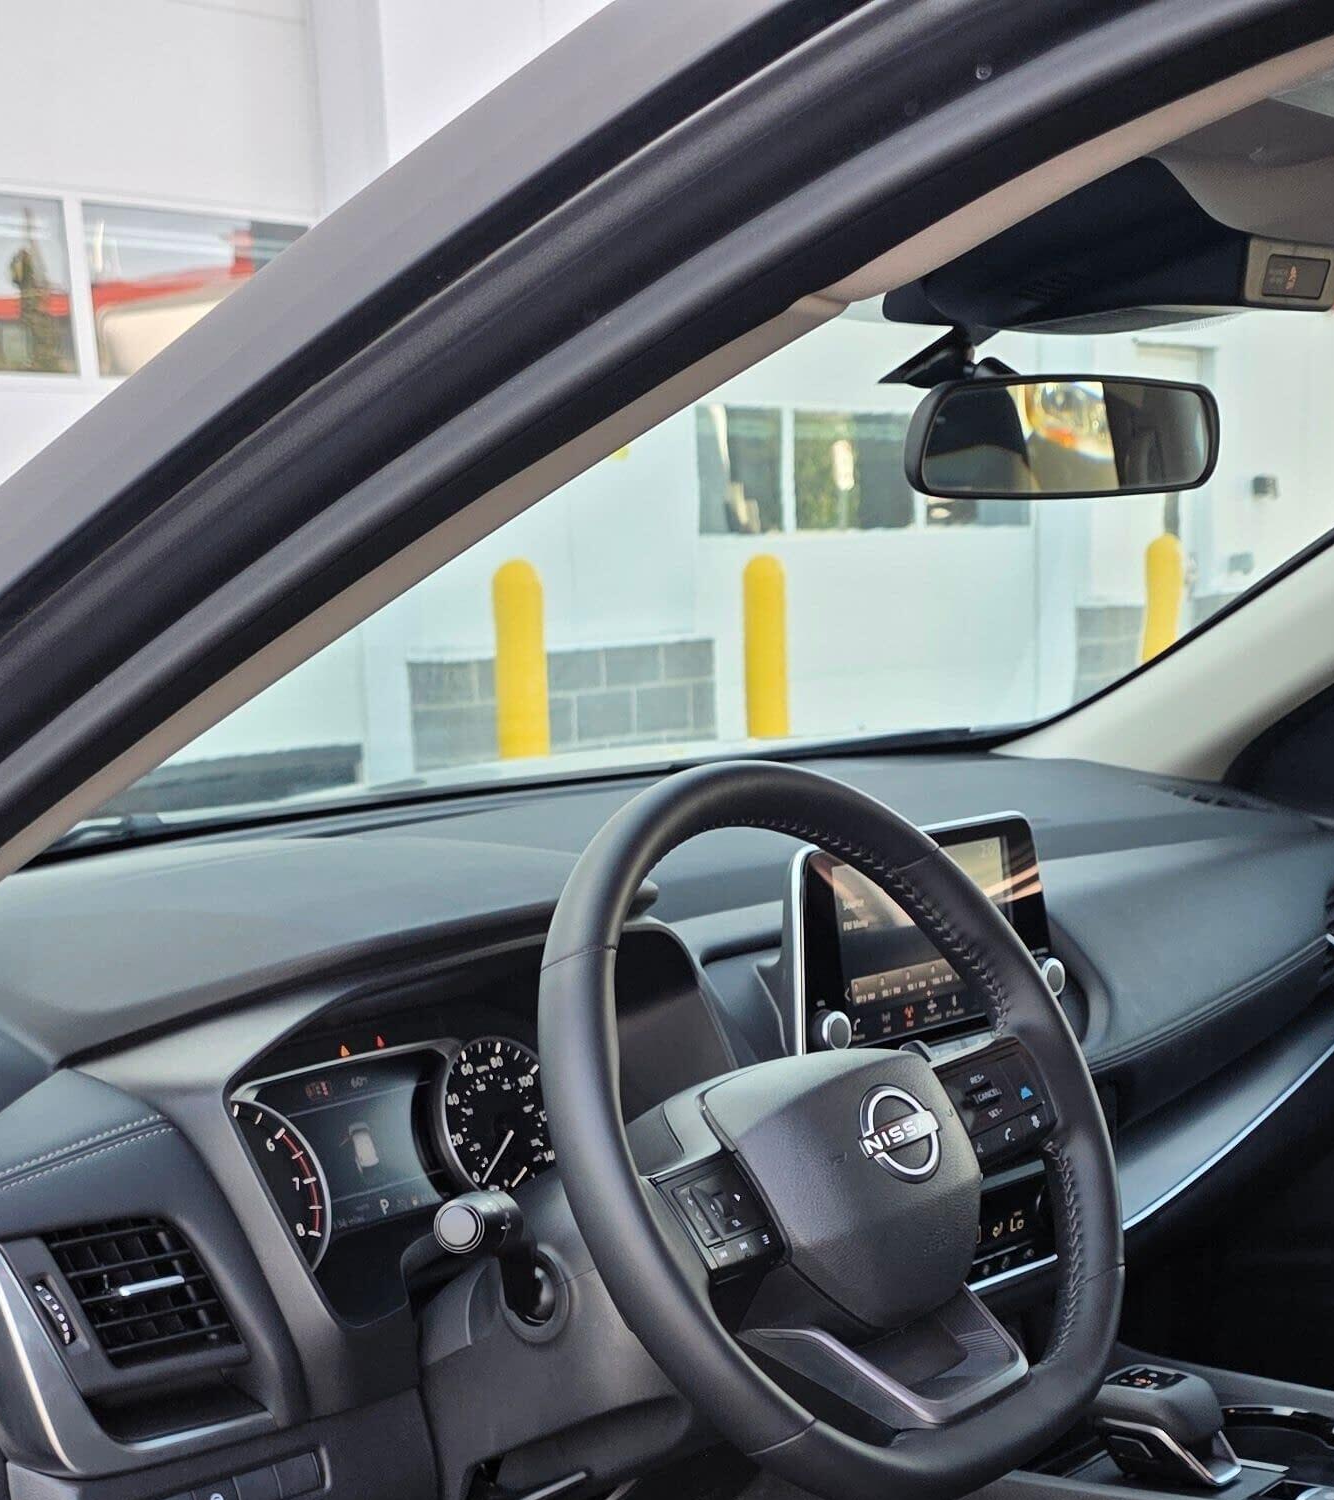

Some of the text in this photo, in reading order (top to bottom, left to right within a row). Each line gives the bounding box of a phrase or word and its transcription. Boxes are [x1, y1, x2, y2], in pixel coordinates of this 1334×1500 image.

[490, 1055, 503, 1068] 80
[461, 1063, 473, 1076] 60
[518, 1074, 534, 1087] 100
[447, 1093, 459, 1105] 40
[451, 1133, 463, 1146] 20
[863, 1113, 931, 1155] NISS
[266, 1138, 276, 1151] 6
[472, 1171, 480, 1183] 0
[292, 1177, 300, 1191] 7
[380, 1198, 389, 1215] P
[295, 1223, 305, 1237] 8
